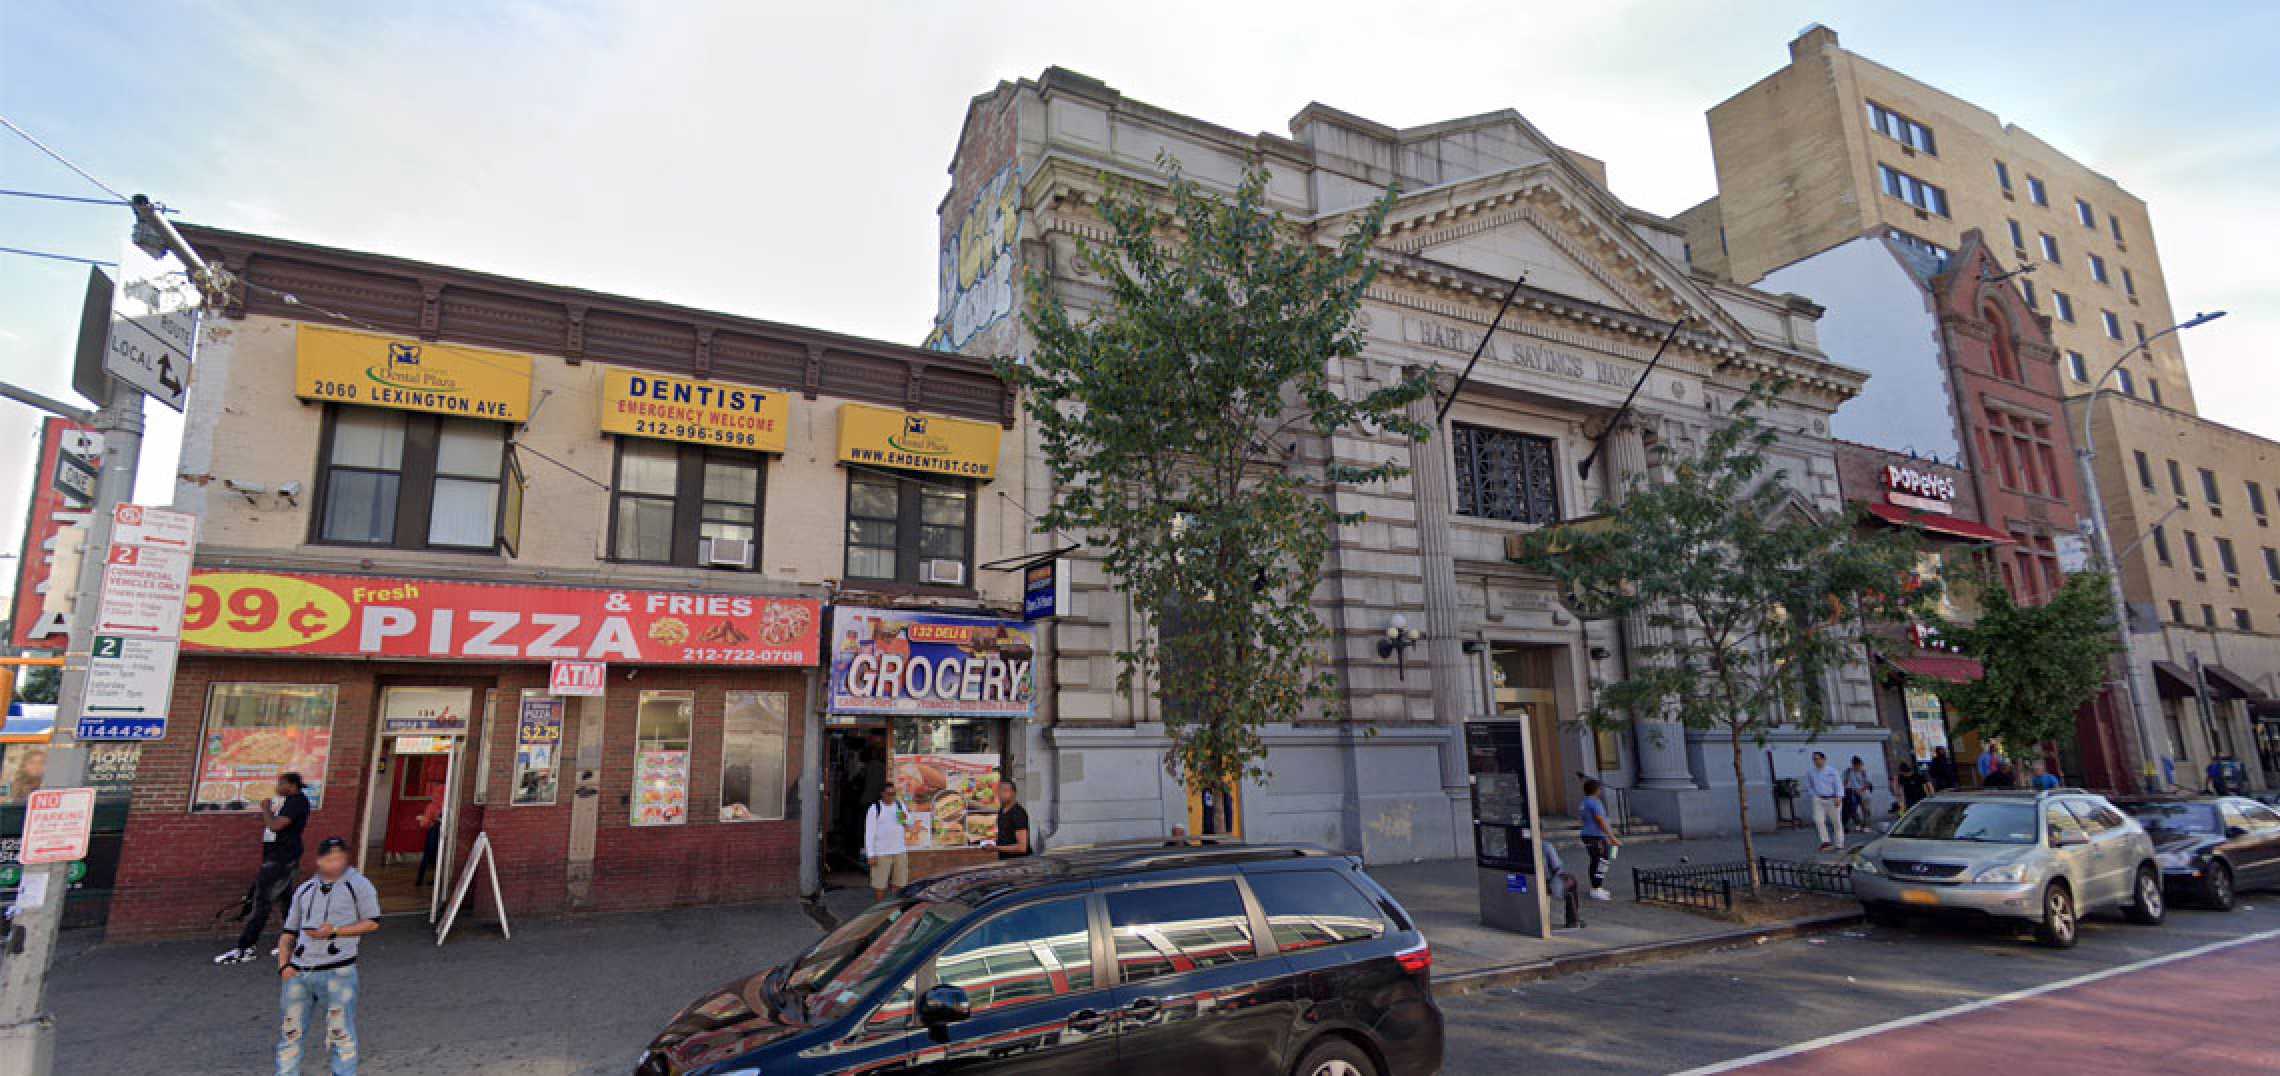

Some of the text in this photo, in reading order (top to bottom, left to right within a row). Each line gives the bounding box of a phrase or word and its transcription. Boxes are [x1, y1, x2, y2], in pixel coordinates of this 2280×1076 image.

[111, 335, 153, 371] LOCAL
[1512, 344, 1585, 380] SAVINGS
[314, 381, 513, 417] 2060 LEXINGTON AVE.
[629, 376, 767, 413] DENTIST
[617, 400, 775, 433] EMERGENCY WELCOME
[117, 547, 131, 563] 2
[351, 583, 419, 604] Fresh
[359, 605, 641, 660] PIZZA
[605, 591, 642, 613] &
[646, 594, 753, 618] FRIES
[100, 639, 117, 657] 2
[557, 663, 604, 689] ATM
[849, 655, 1029, 702] GROCERY
[36, 796, 60, 809] NO
